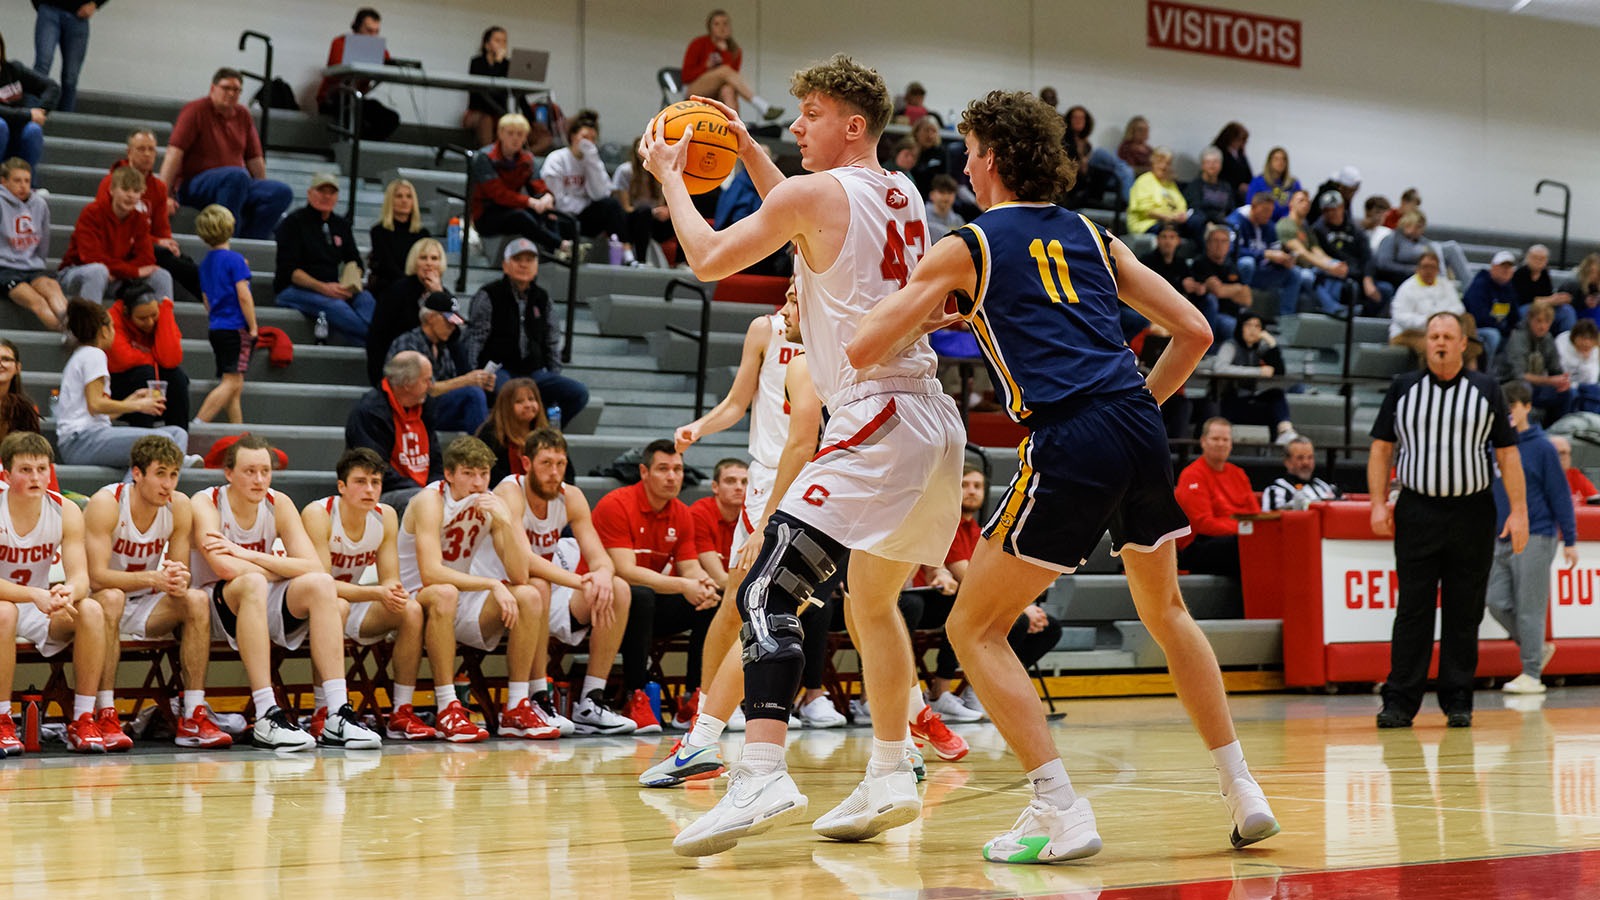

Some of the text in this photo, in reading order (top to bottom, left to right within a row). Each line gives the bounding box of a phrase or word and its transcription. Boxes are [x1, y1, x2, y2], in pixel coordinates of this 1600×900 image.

[1153, 5, 1296, 60] VISITORS
[1029, 239, 1080, 303] 11
[803, 484, 830, 507] C
[0, 543, 54, 563] DUTCH
[1345, 570, 1399, 609] CEN
[1558, 569, 1600, 605] DU
